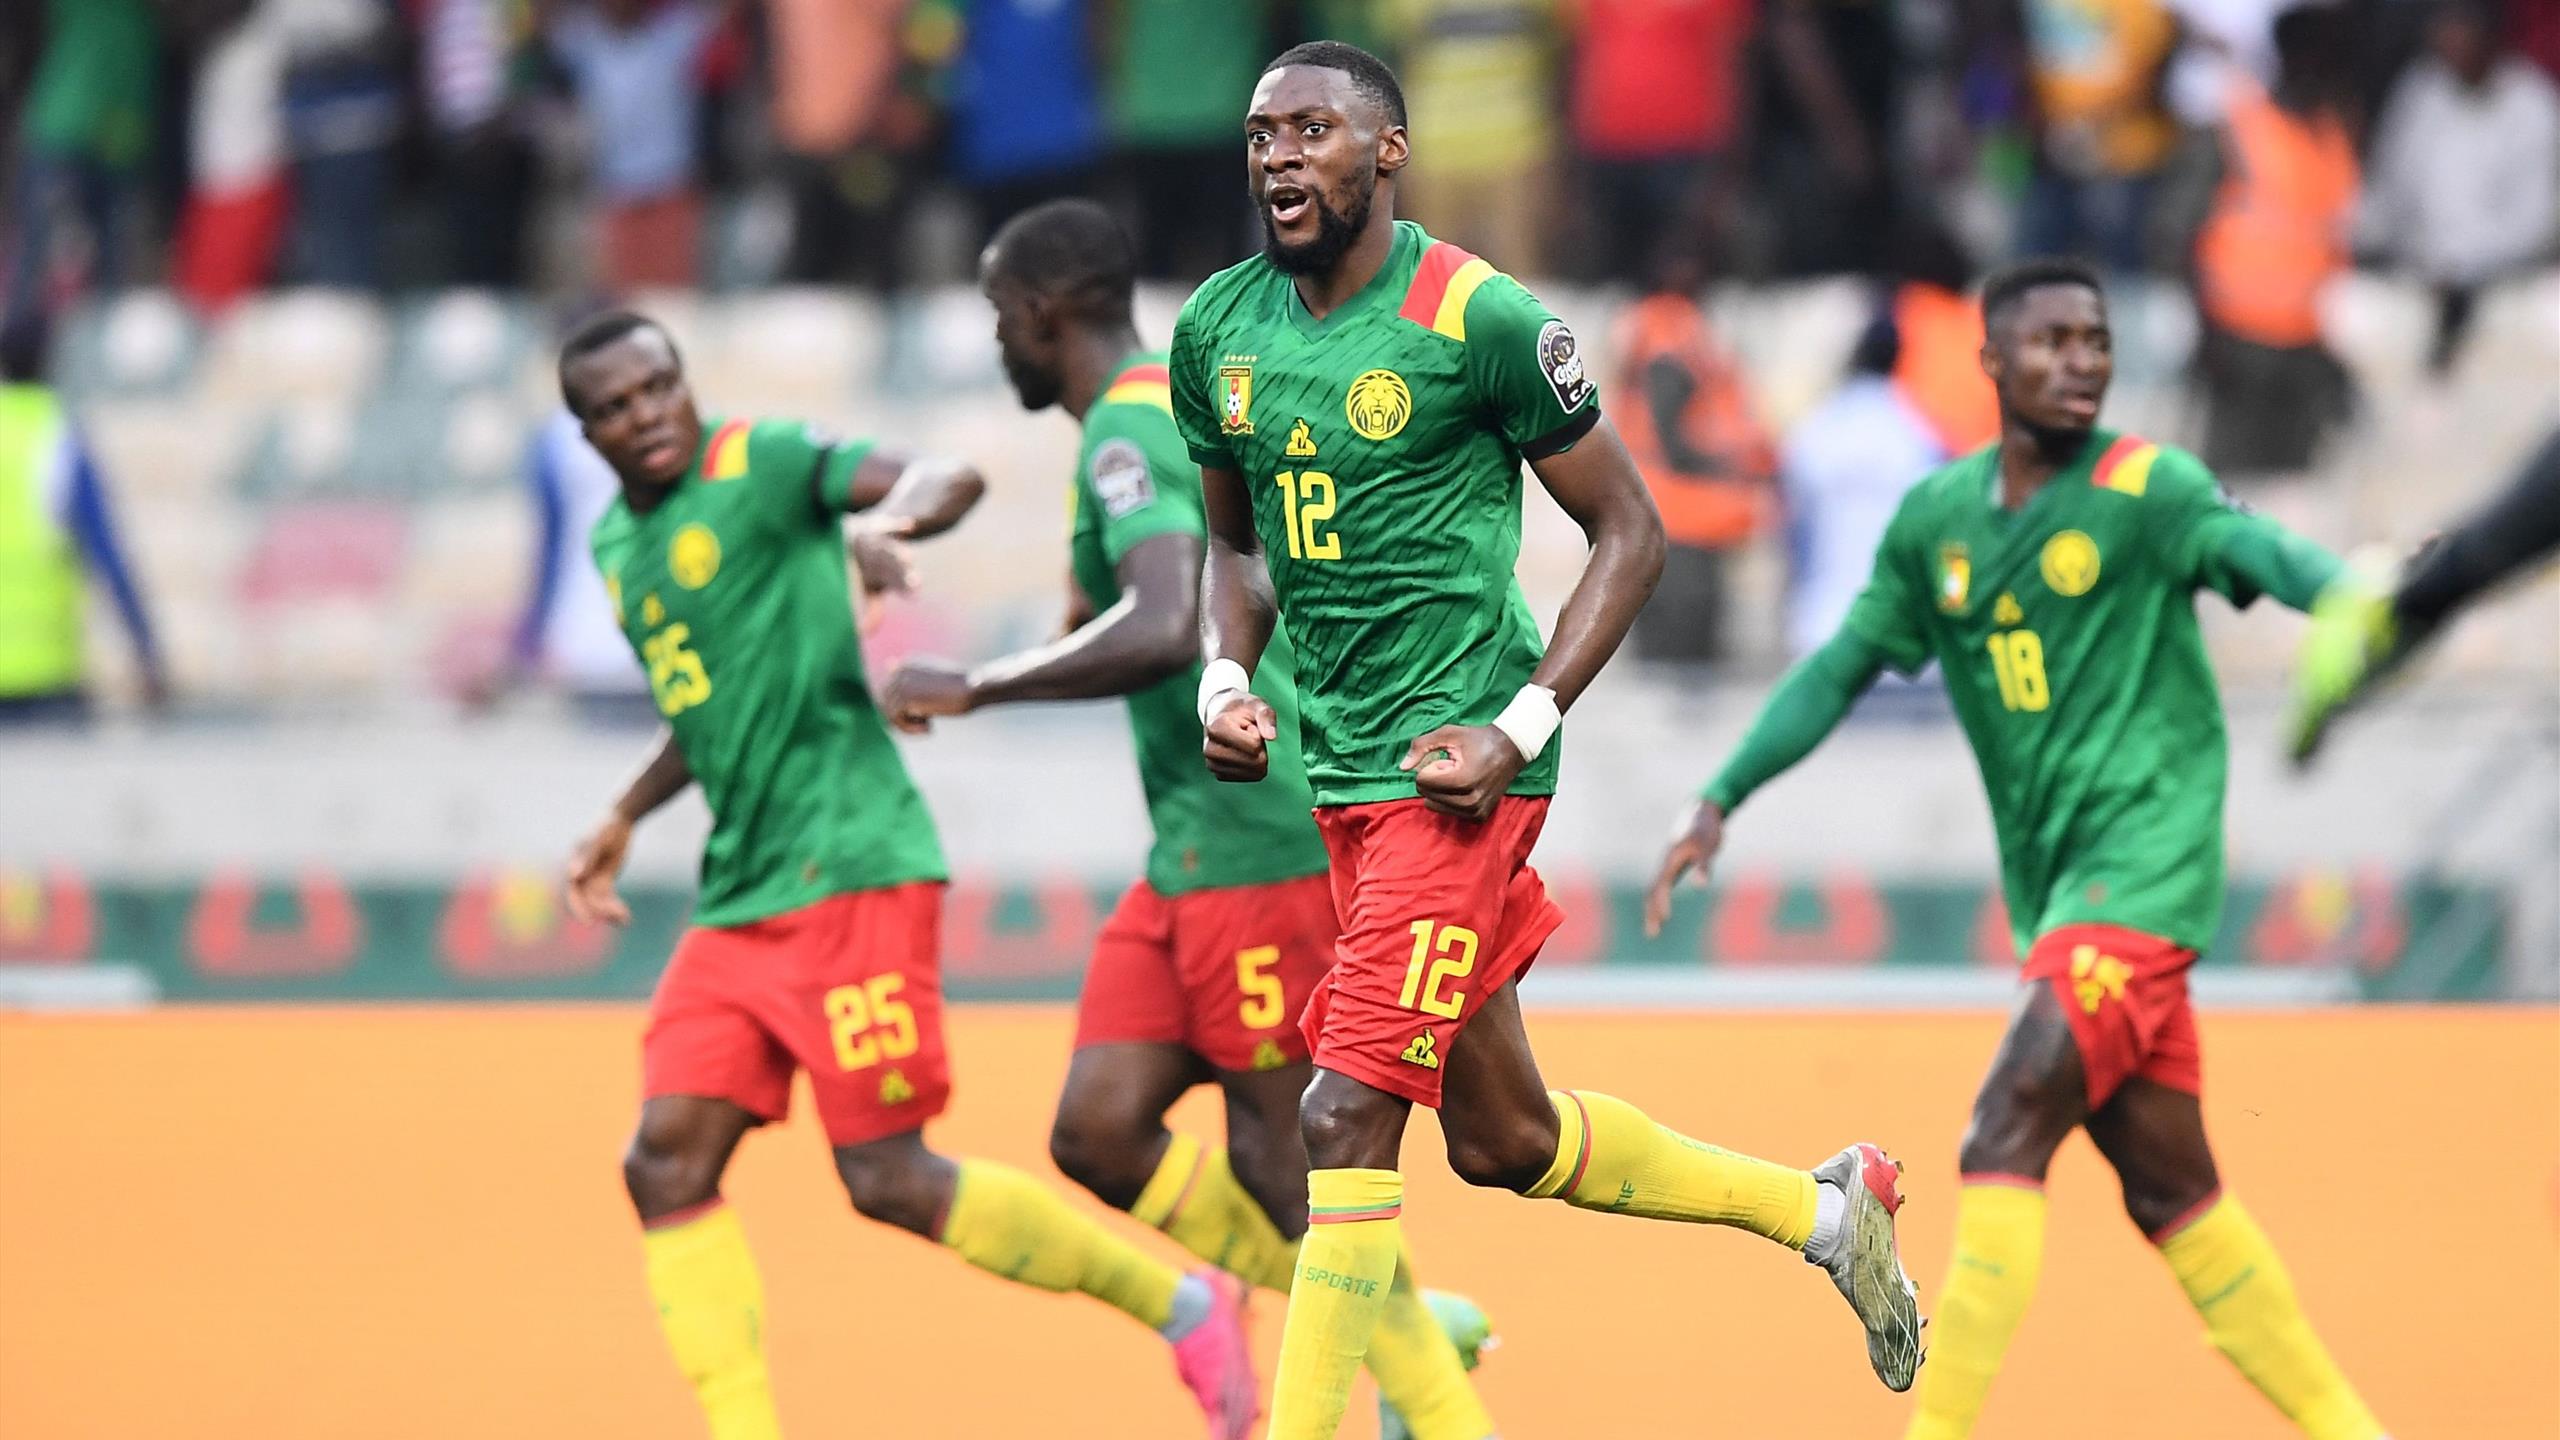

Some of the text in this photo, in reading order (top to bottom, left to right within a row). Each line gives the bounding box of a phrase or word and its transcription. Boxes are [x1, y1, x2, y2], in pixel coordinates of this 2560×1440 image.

[1276, 470, 1341, 560] 12
[1986, 629, 2049, 712] 18
[1236, 945, 1284, 1030] 5
[1398, 920, 1478, 1019] 12
[824, 972, 918, 1072] 25
[1305, 1266, 1378, 1298] SPORTIF
